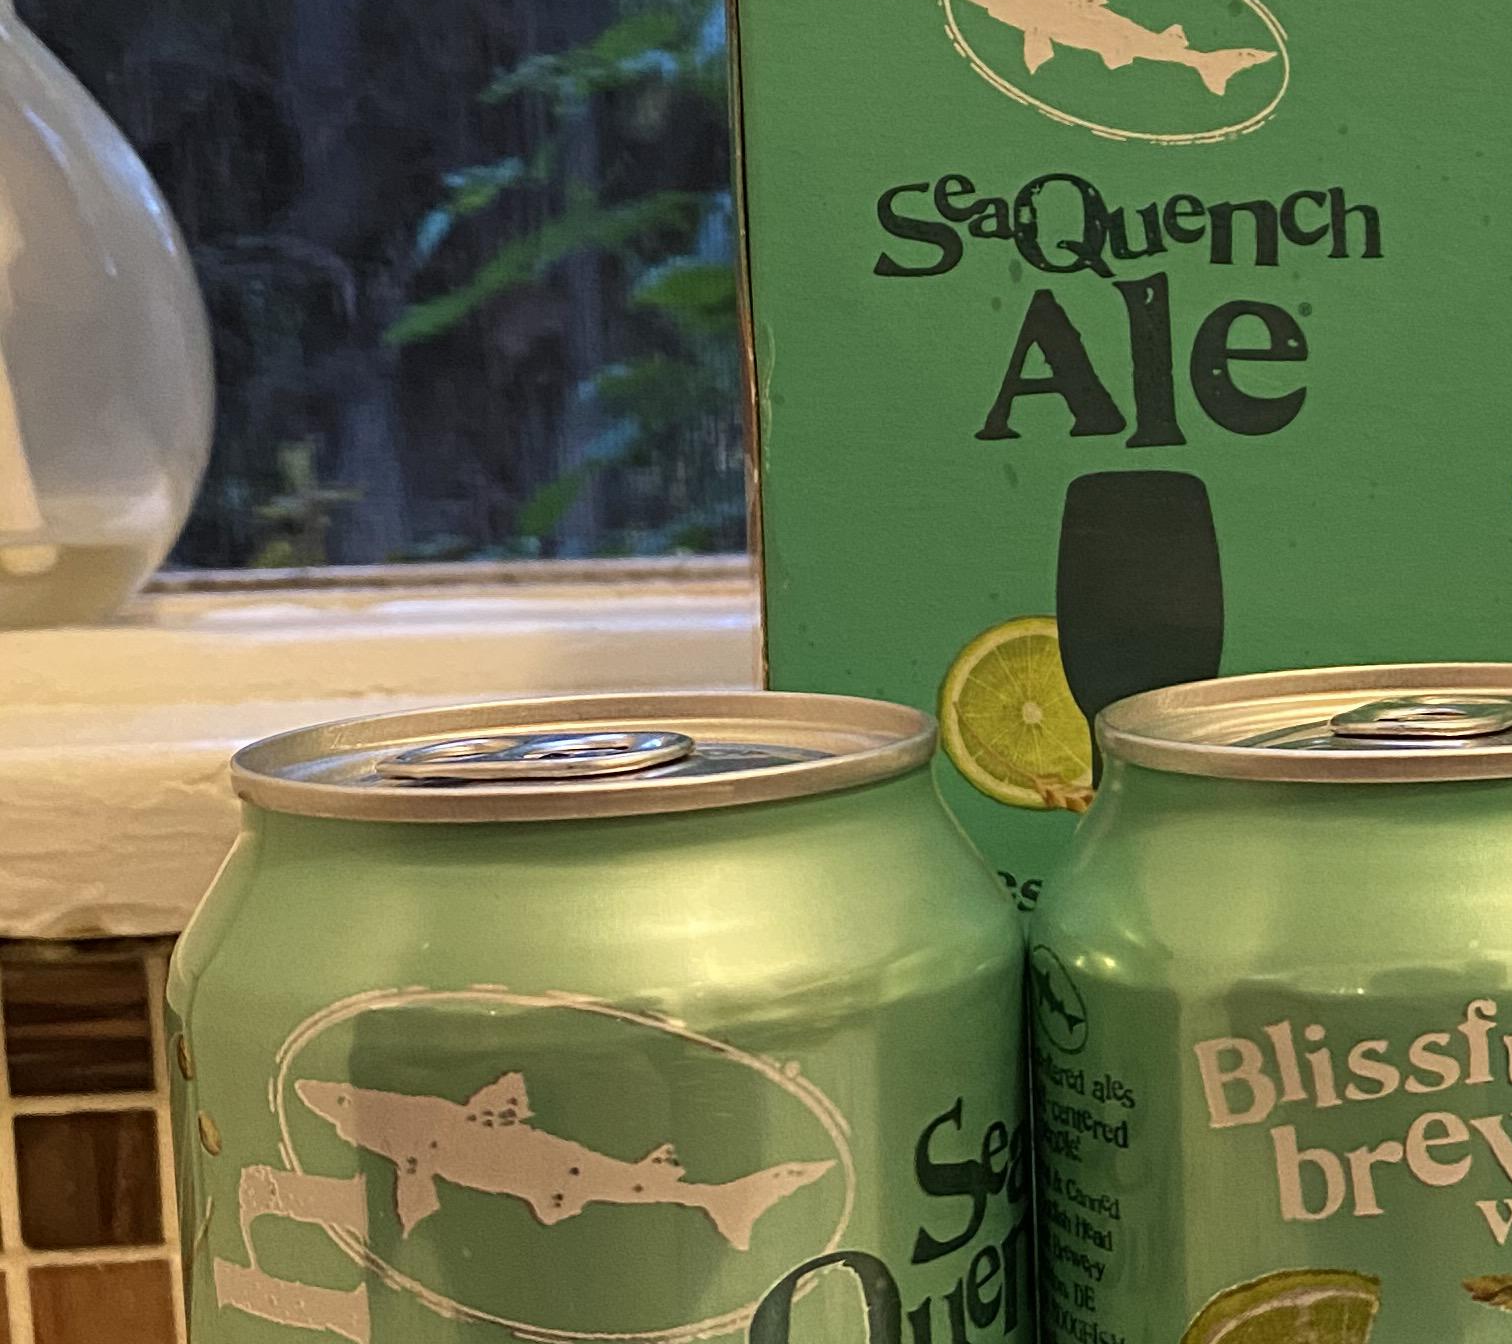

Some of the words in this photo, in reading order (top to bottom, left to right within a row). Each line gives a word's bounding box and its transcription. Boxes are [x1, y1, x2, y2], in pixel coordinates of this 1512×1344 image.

[873, 172, 1384, 278] SeaQuench
[974, 271, 1309, 448] Ale
[1050, 1100, 1129, 1149] centered
[1092, 1073, 1136, 1109] ales
